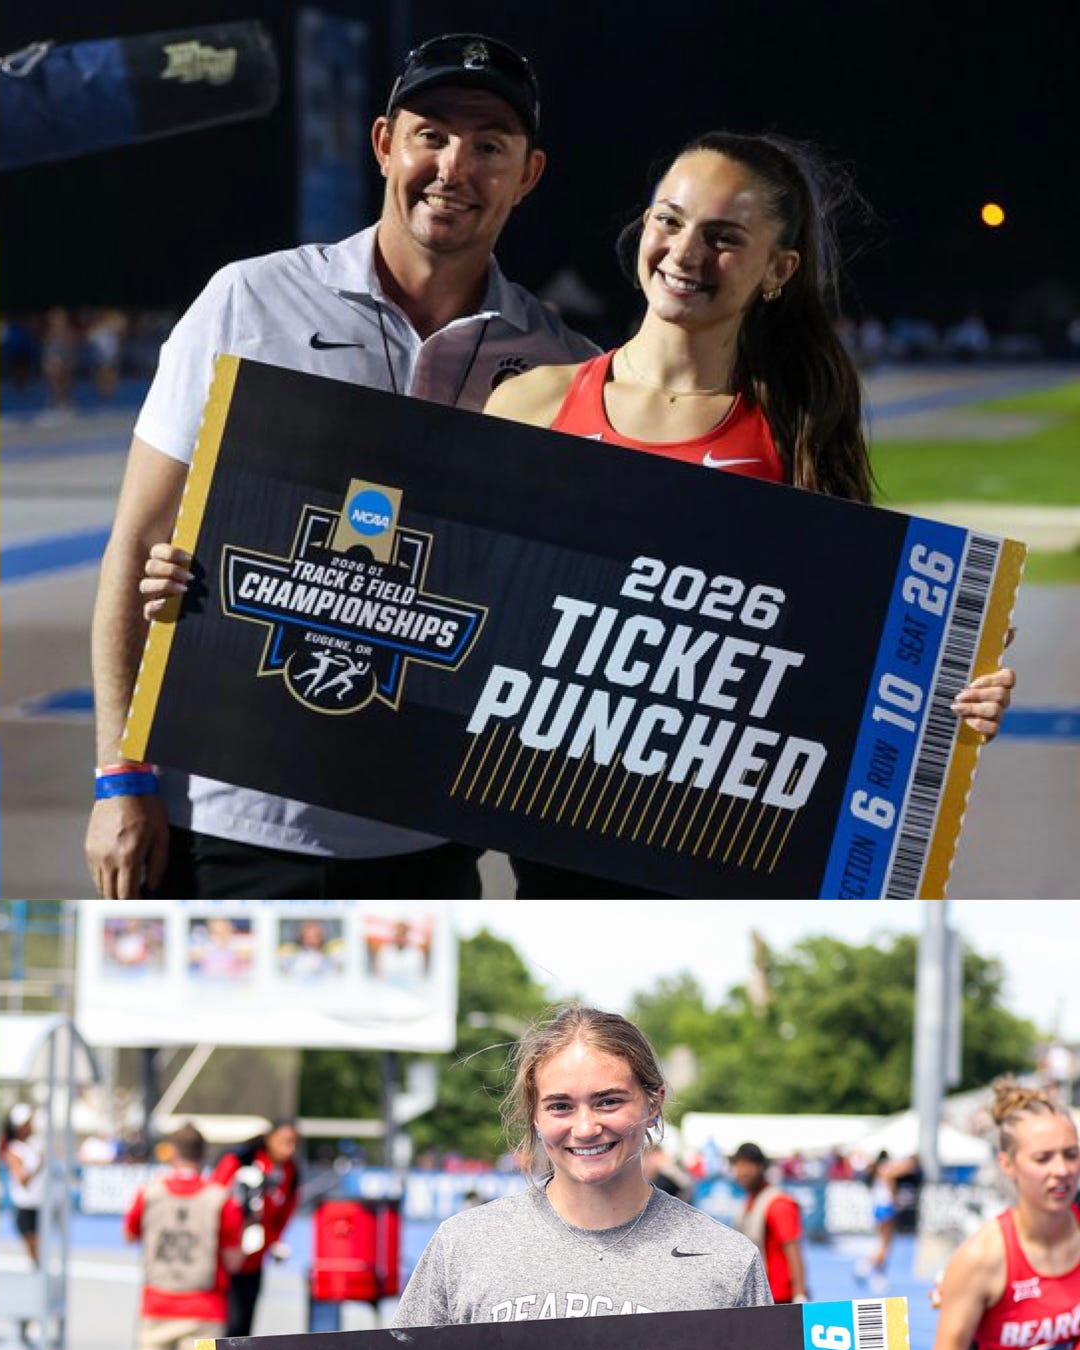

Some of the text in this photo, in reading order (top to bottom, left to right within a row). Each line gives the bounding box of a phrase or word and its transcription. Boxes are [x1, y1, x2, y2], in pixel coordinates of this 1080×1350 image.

[350, 509, 390, 529] NCAA
[238, 572, 459, 648] CHAMPIONSHIPS
[291, 559, 416, 605] TRACK & FIELD
[620, 555, 786, 630] 2026
[902, 544, 955, 617] 26
[541, 594, 806, 719] TICKET
[896, 613, 928, 665] SEAT
[873, 672, 923, 733] 10
[466, 664, 828, 811] PUNCHED
[867, 739, 899, 790] ROW
[850, 789, 896, 830] 6
